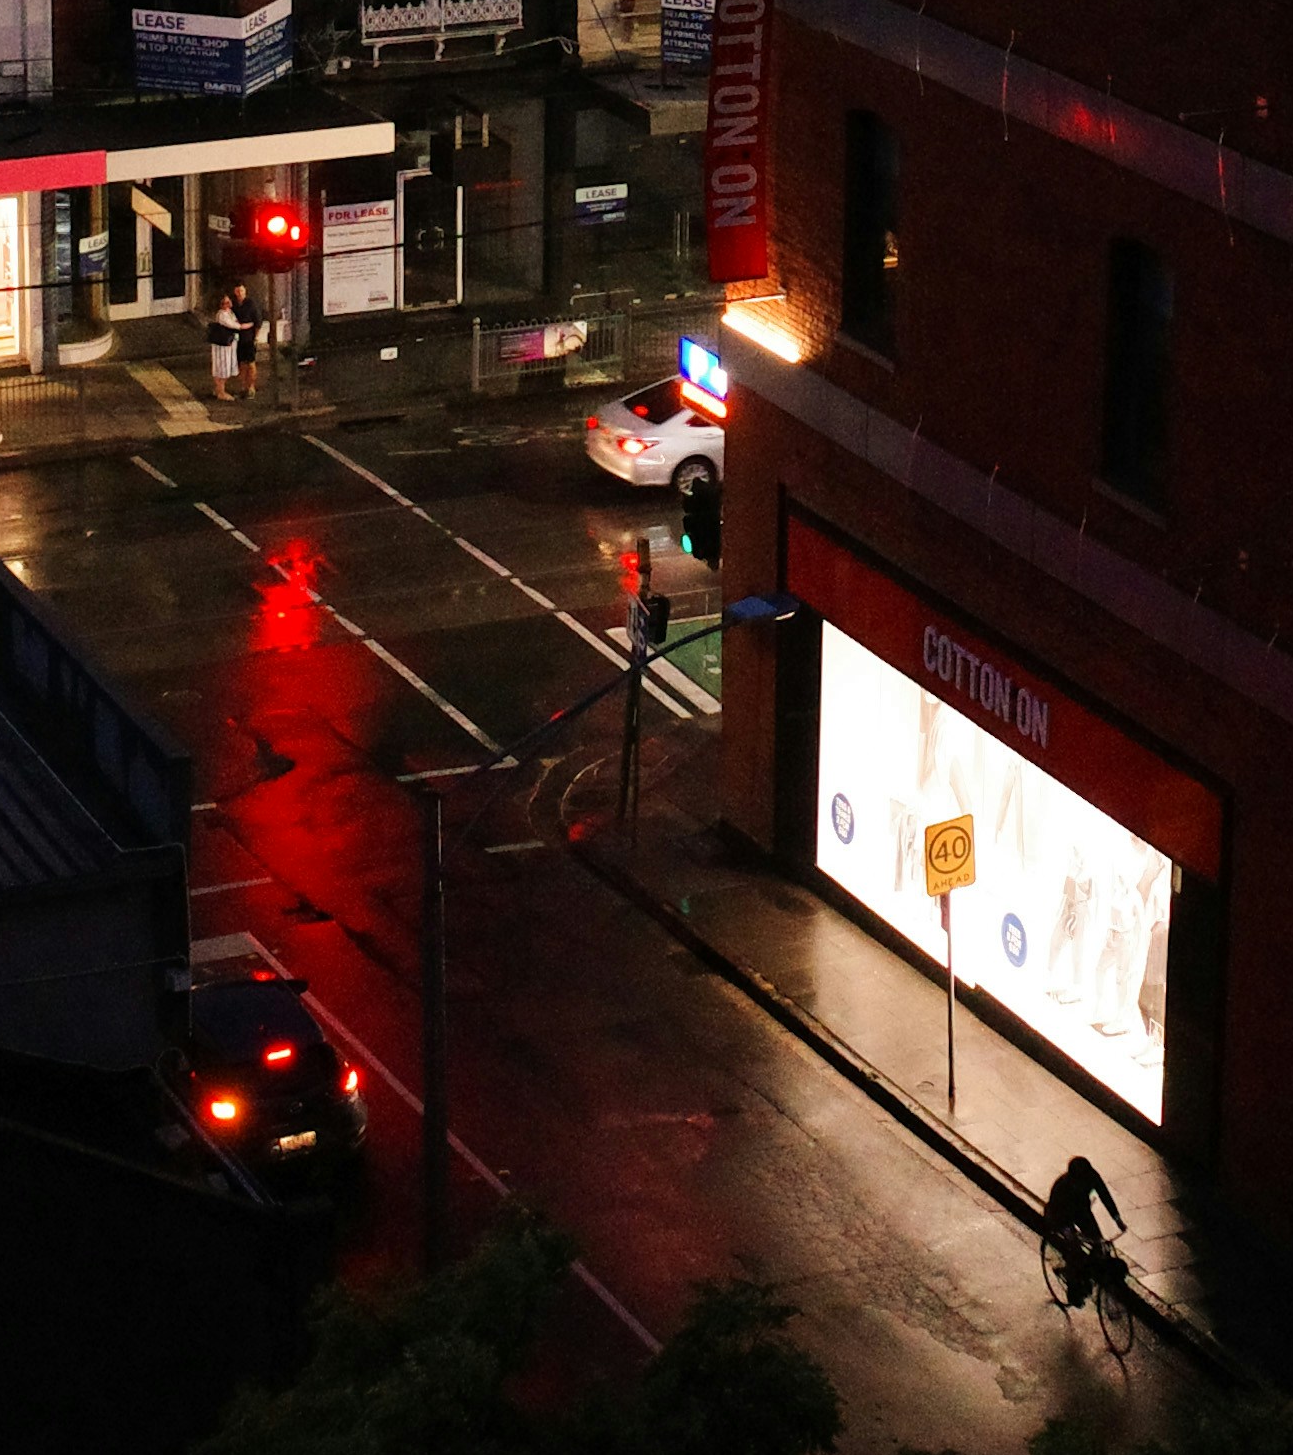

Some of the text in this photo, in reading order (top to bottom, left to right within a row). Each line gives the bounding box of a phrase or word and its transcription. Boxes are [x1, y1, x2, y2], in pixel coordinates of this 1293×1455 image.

[135, 12, 186, 31] LEASE
[244, 10, 268, 34] LEASE
[135, 31, 230, 49] PRIME RETAIL SHOP
[135, 42, 221, 58] IN TOP LOCATION
[585, 187, 618, 199] LEASE
[711, 163, 759, 228] ON
[328, 207, 390, 221] FOR LEASE
[923, 625, 1049, 750] COTTON ON
[934, 835, 966, 862] 40
[932, 873, 970, 891] AHEAD
